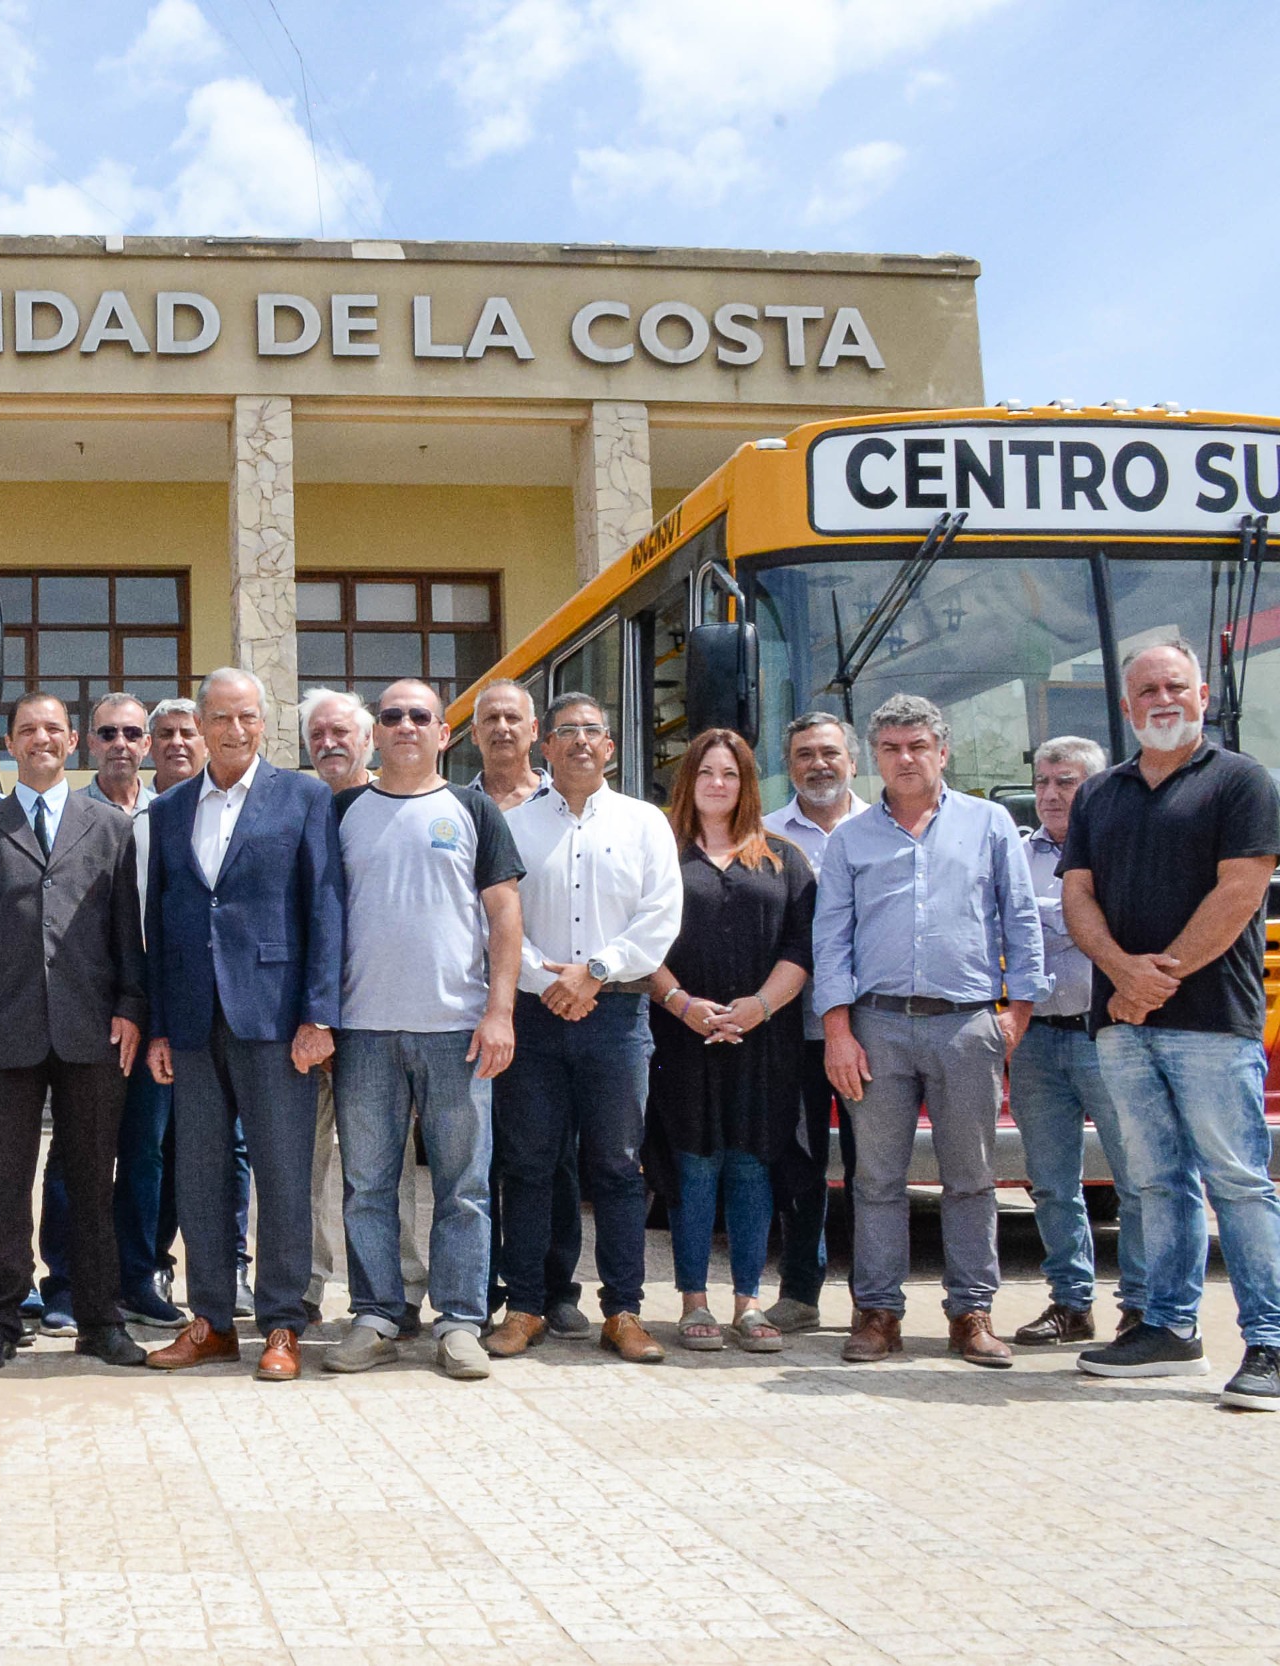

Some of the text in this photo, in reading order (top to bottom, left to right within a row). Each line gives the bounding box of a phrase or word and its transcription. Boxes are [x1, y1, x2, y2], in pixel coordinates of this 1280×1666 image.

[257, 292, 381, 357] DE
[413, 295, 535, 360] LA
[571, 300, 886, 369] COSTA
[845, 437, 1280, 514] CENTRO SU
